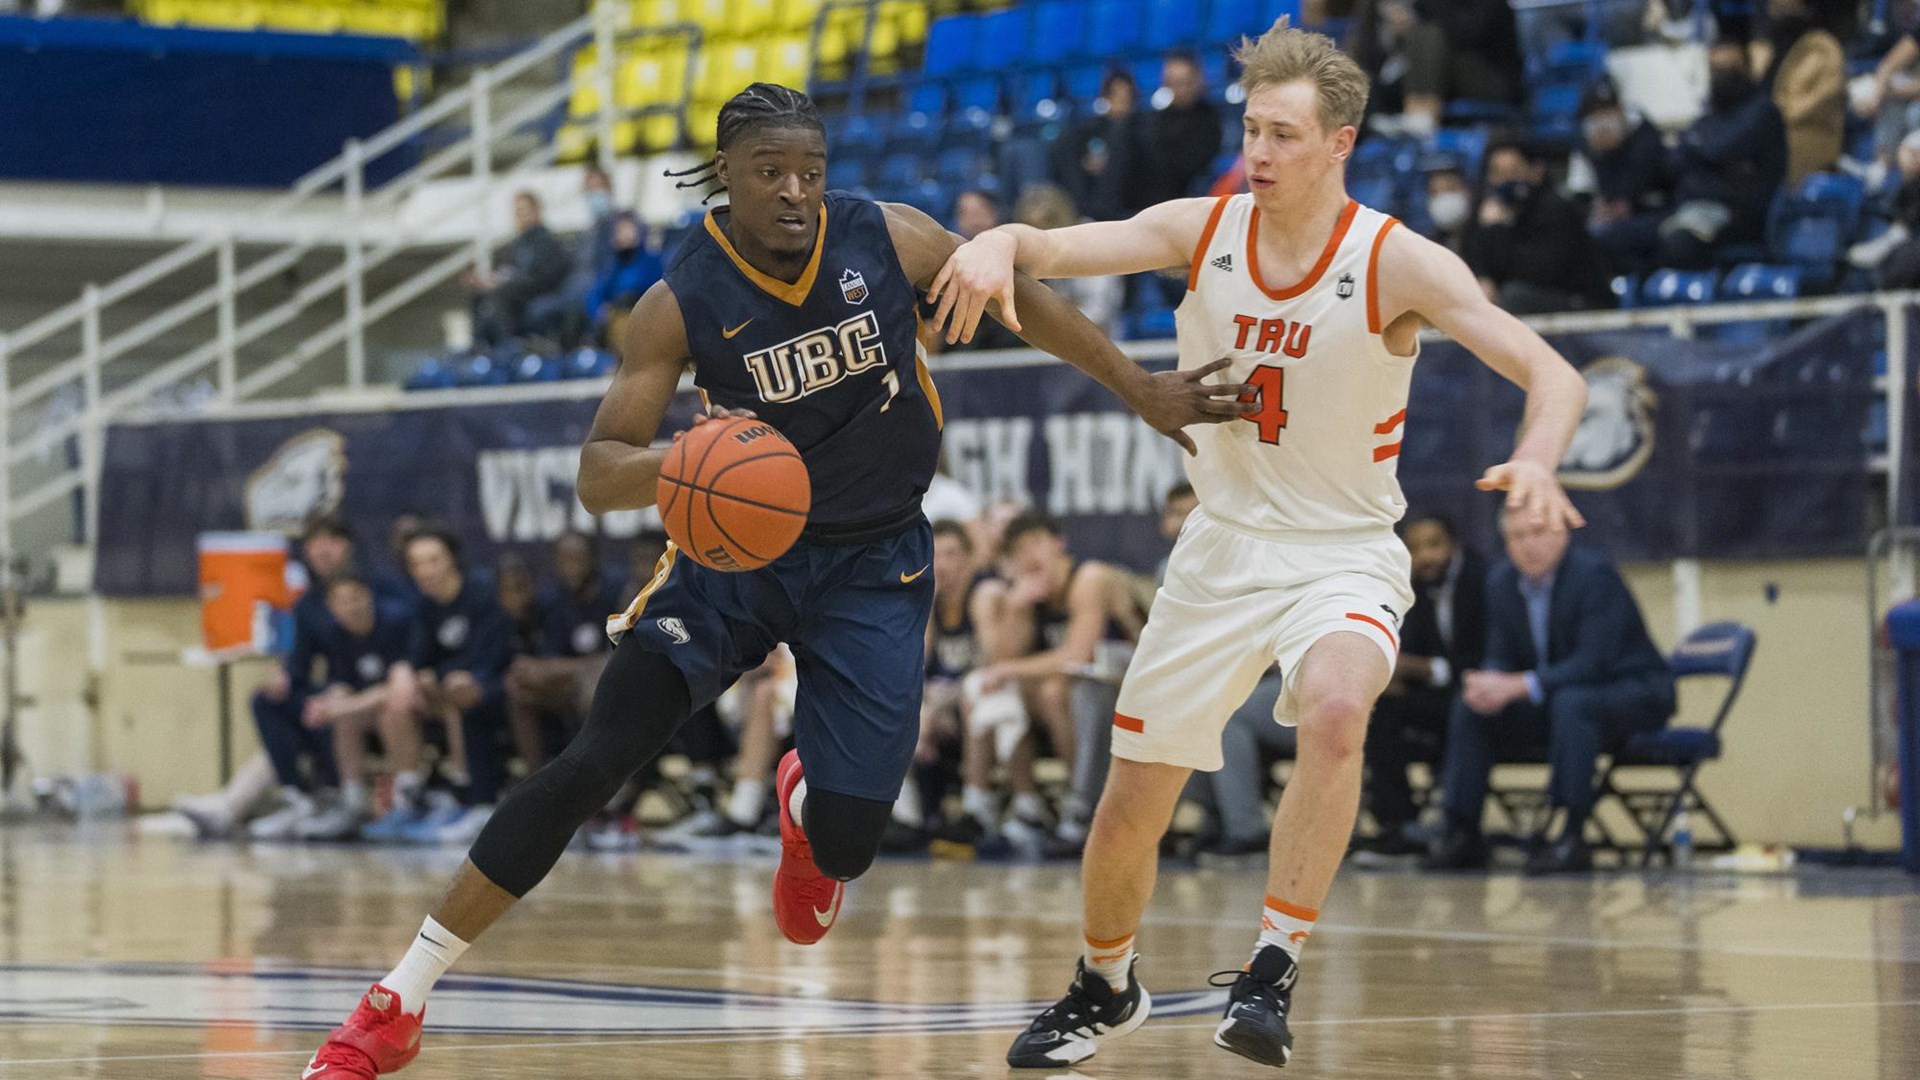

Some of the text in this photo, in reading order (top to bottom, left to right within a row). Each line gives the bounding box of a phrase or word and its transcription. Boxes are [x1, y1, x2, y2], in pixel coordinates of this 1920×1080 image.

[845, 286, 866, 300] WEST
[743, 310, 887, 403] UBC
[1233, 314, 1312, 359] TRU
[879, 369, 900, 414] 1
[1235, 364, 1288, 446] 4
